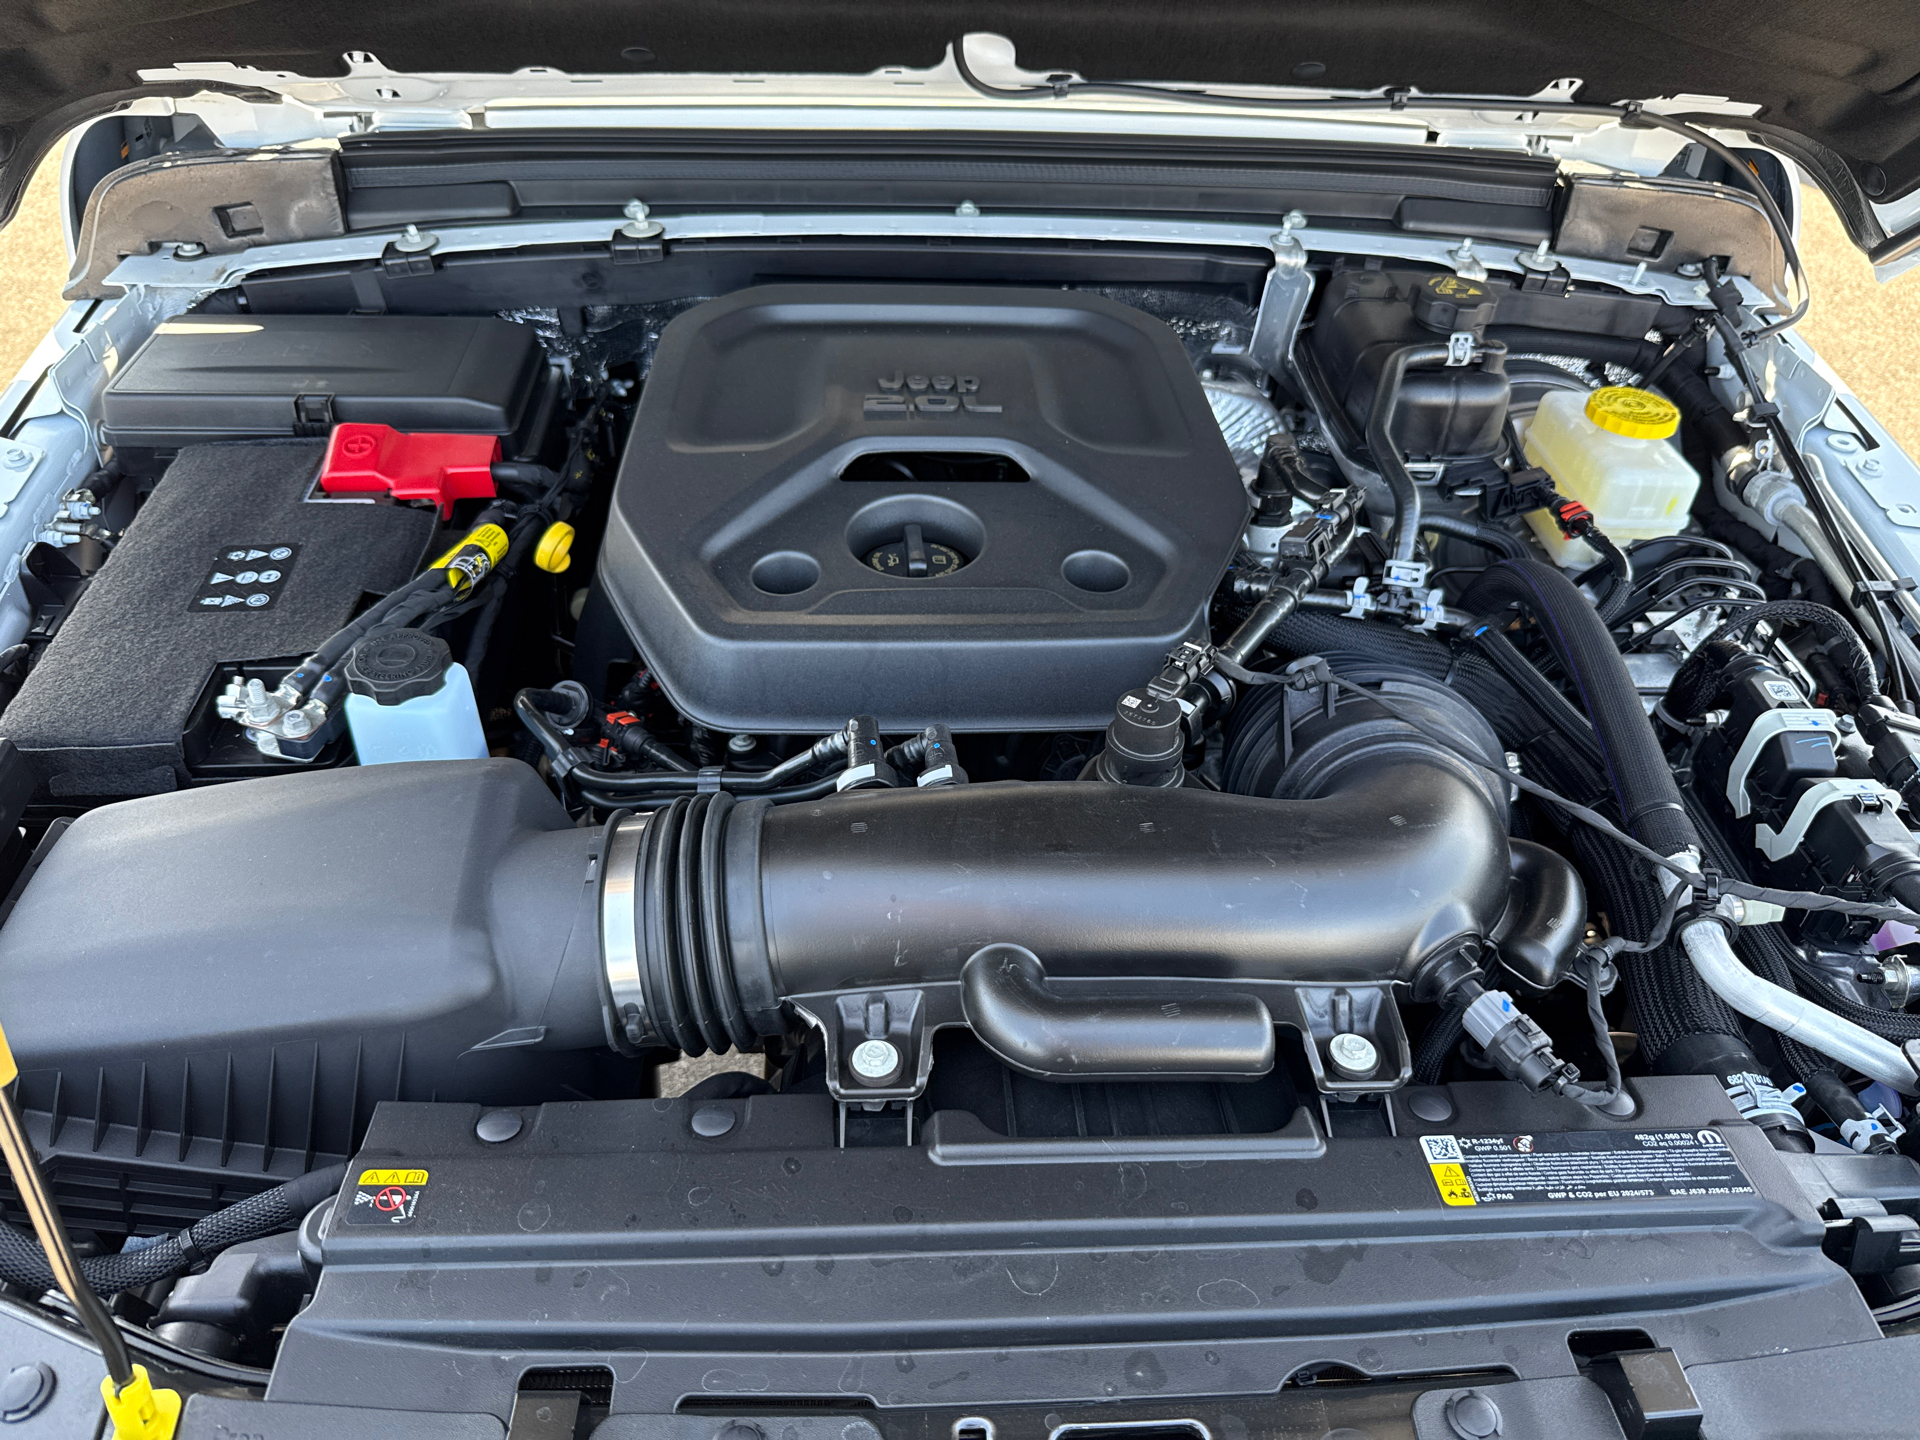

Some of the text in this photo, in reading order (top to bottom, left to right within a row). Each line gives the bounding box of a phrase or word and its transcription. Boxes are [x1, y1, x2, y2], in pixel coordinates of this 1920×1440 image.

[878, 370, 980, 393] Jeep
[863, 394, 1002, 413] 2.0L
[1496, 1192, 1514, 1200] PAG
[1594, 1191, 1607, 1199] per
